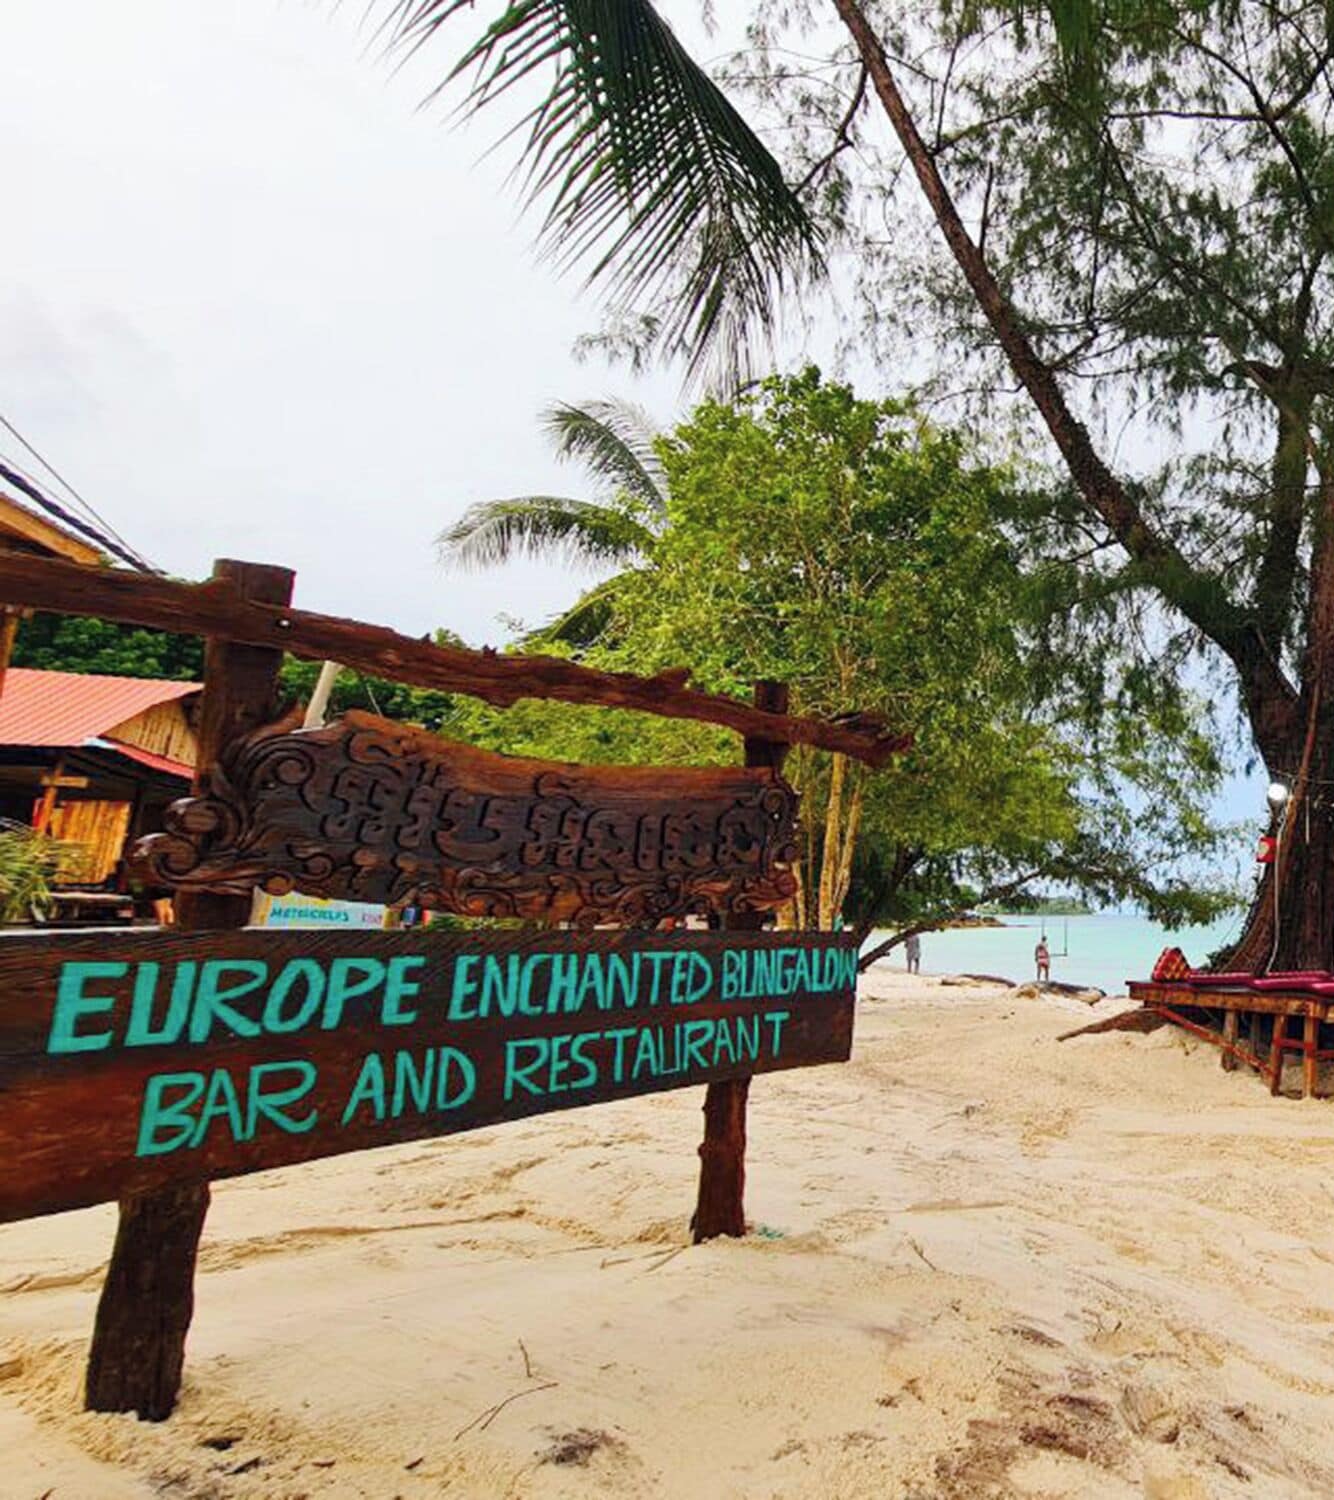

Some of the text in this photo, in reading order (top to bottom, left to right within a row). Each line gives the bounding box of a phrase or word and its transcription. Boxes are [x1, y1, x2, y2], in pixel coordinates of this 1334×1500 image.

[47, 948, 858, 1054] EUROPE ENCHANTED BUNGALOW
[137, 1012, 789, 1157] BAR AND RESTAURANT
